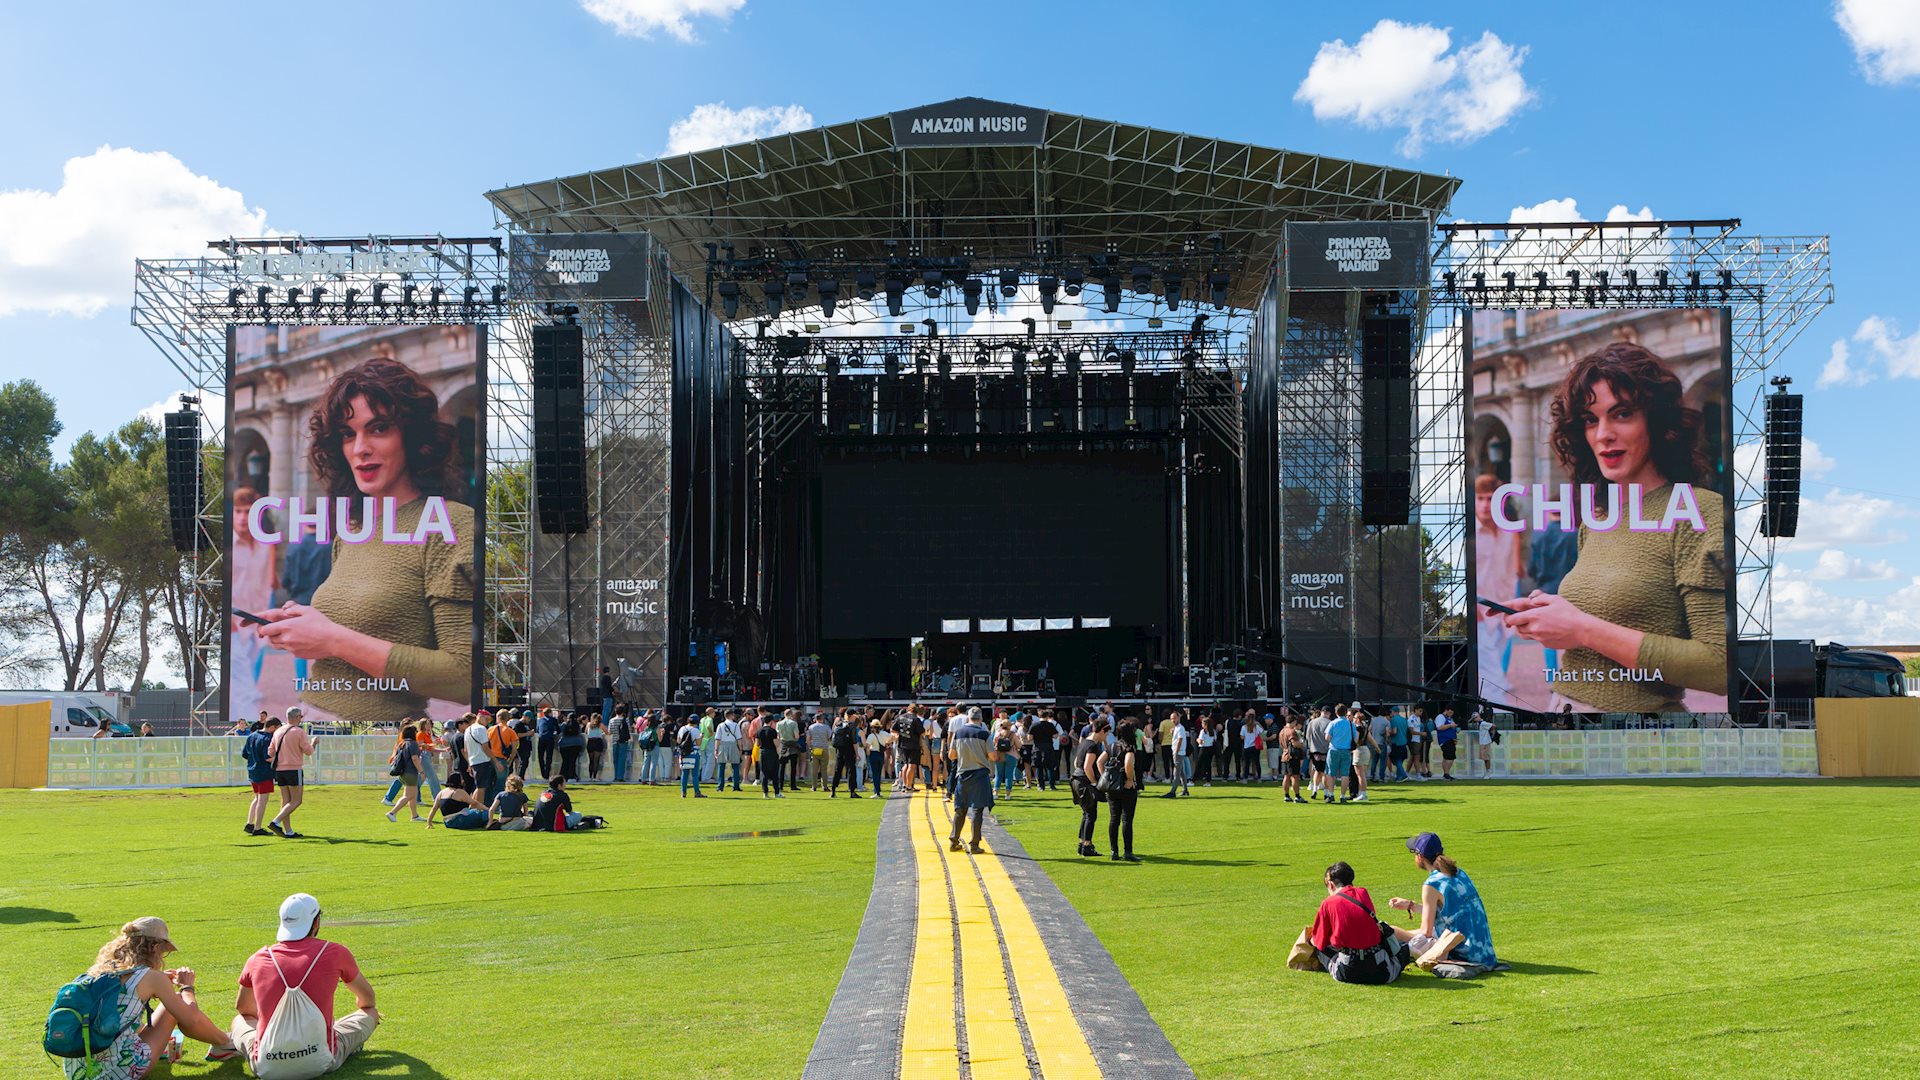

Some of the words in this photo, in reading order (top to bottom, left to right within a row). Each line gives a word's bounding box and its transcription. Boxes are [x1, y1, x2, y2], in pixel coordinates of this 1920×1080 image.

[911, 117, 974, 133] AMAZON
[979, 116, 1027, 132] MUSIC
[1328, 237, 1389, 249] PRIMAVERA
[549, 249, 608, 260] PRIMAVERA
[1325, 249, 1362, 260] SOUND
[1363, 248, 1392, 260] 2023
[240, 254, 346, 275] amazon
[546, 260, 582, 272] SOUND
[584, 260, 611, 271] 2023
[1338, 260, 1379, 272] MADRID
[559, 272, 599, 284] MADRID
[1490, 482, 1707, 532] CHULA
[247, 496, 459, 545] CHULA
[606, 579, 658, 590] amazon
[1291, 573, 1344, 584] amazon
[606, 597, 658, 614] music
[1291, 592, 1344, 608] music
[1542, 668, 1578, 682] That
[1583, 668, 1604, 682] it's
[1609, 668, 1663, 682] CHULA
[292, 678, 326, 691] That
[331, 678, 352, 691] it's
[356, 678, 409, 691] CHULA
[266, 1044, 318, 1060] extremis
